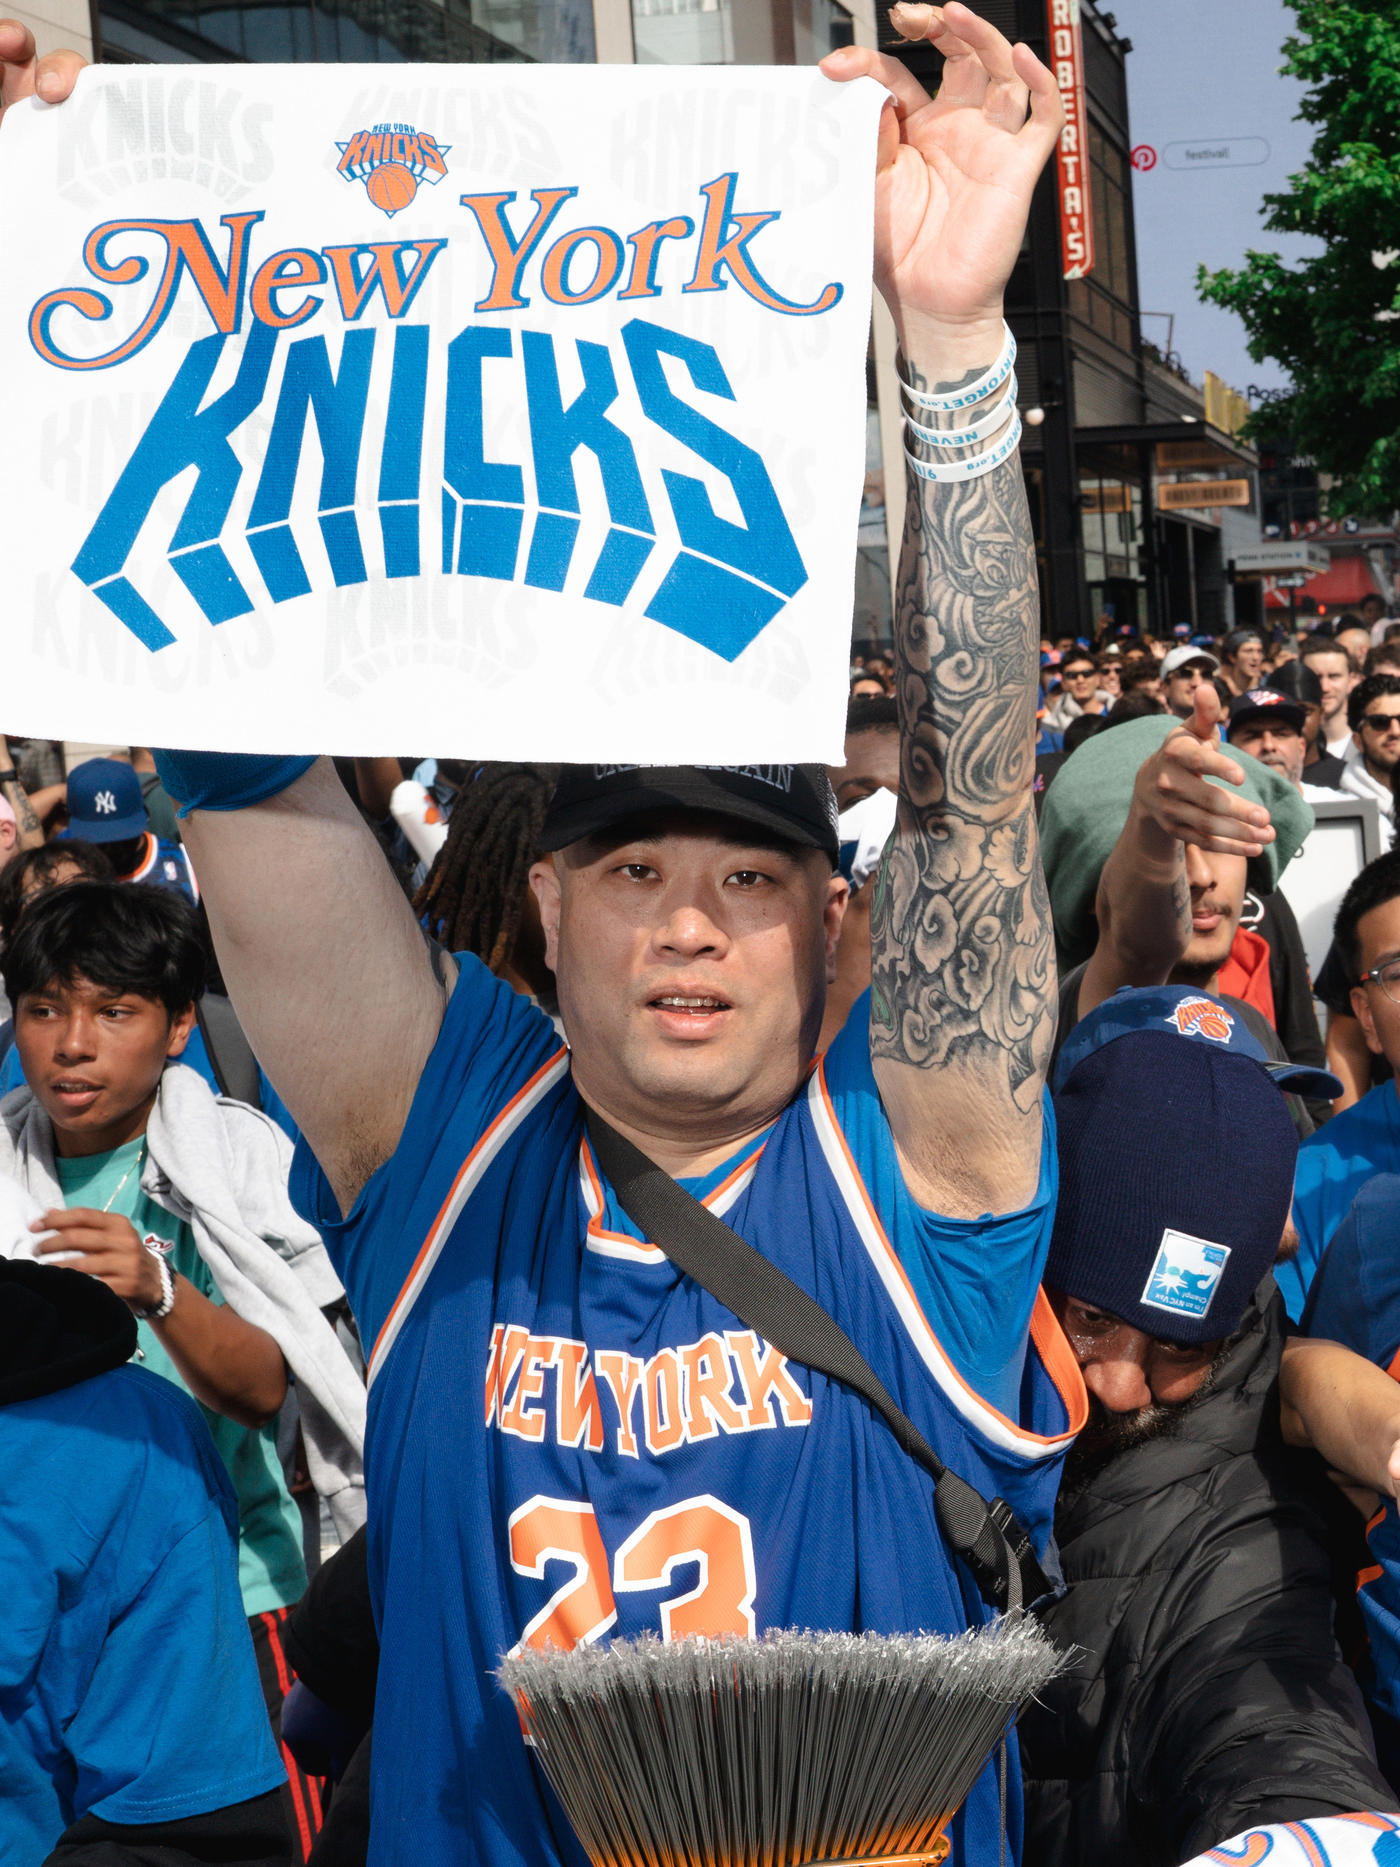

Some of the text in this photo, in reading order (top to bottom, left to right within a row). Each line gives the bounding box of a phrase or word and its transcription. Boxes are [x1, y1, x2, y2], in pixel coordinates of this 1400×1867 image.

[336, 130, 449, 186] KNICKS
[372, 122, 416, 135] NEW YORK
[1053, 0, 1084, 261] ROBERTA'S
[28, 210, 447, 371] New
[459, 172, 844, 315] York
[70, 318, 809, 663] KNICKS
[594, 1329, 813, 1460] YORK
